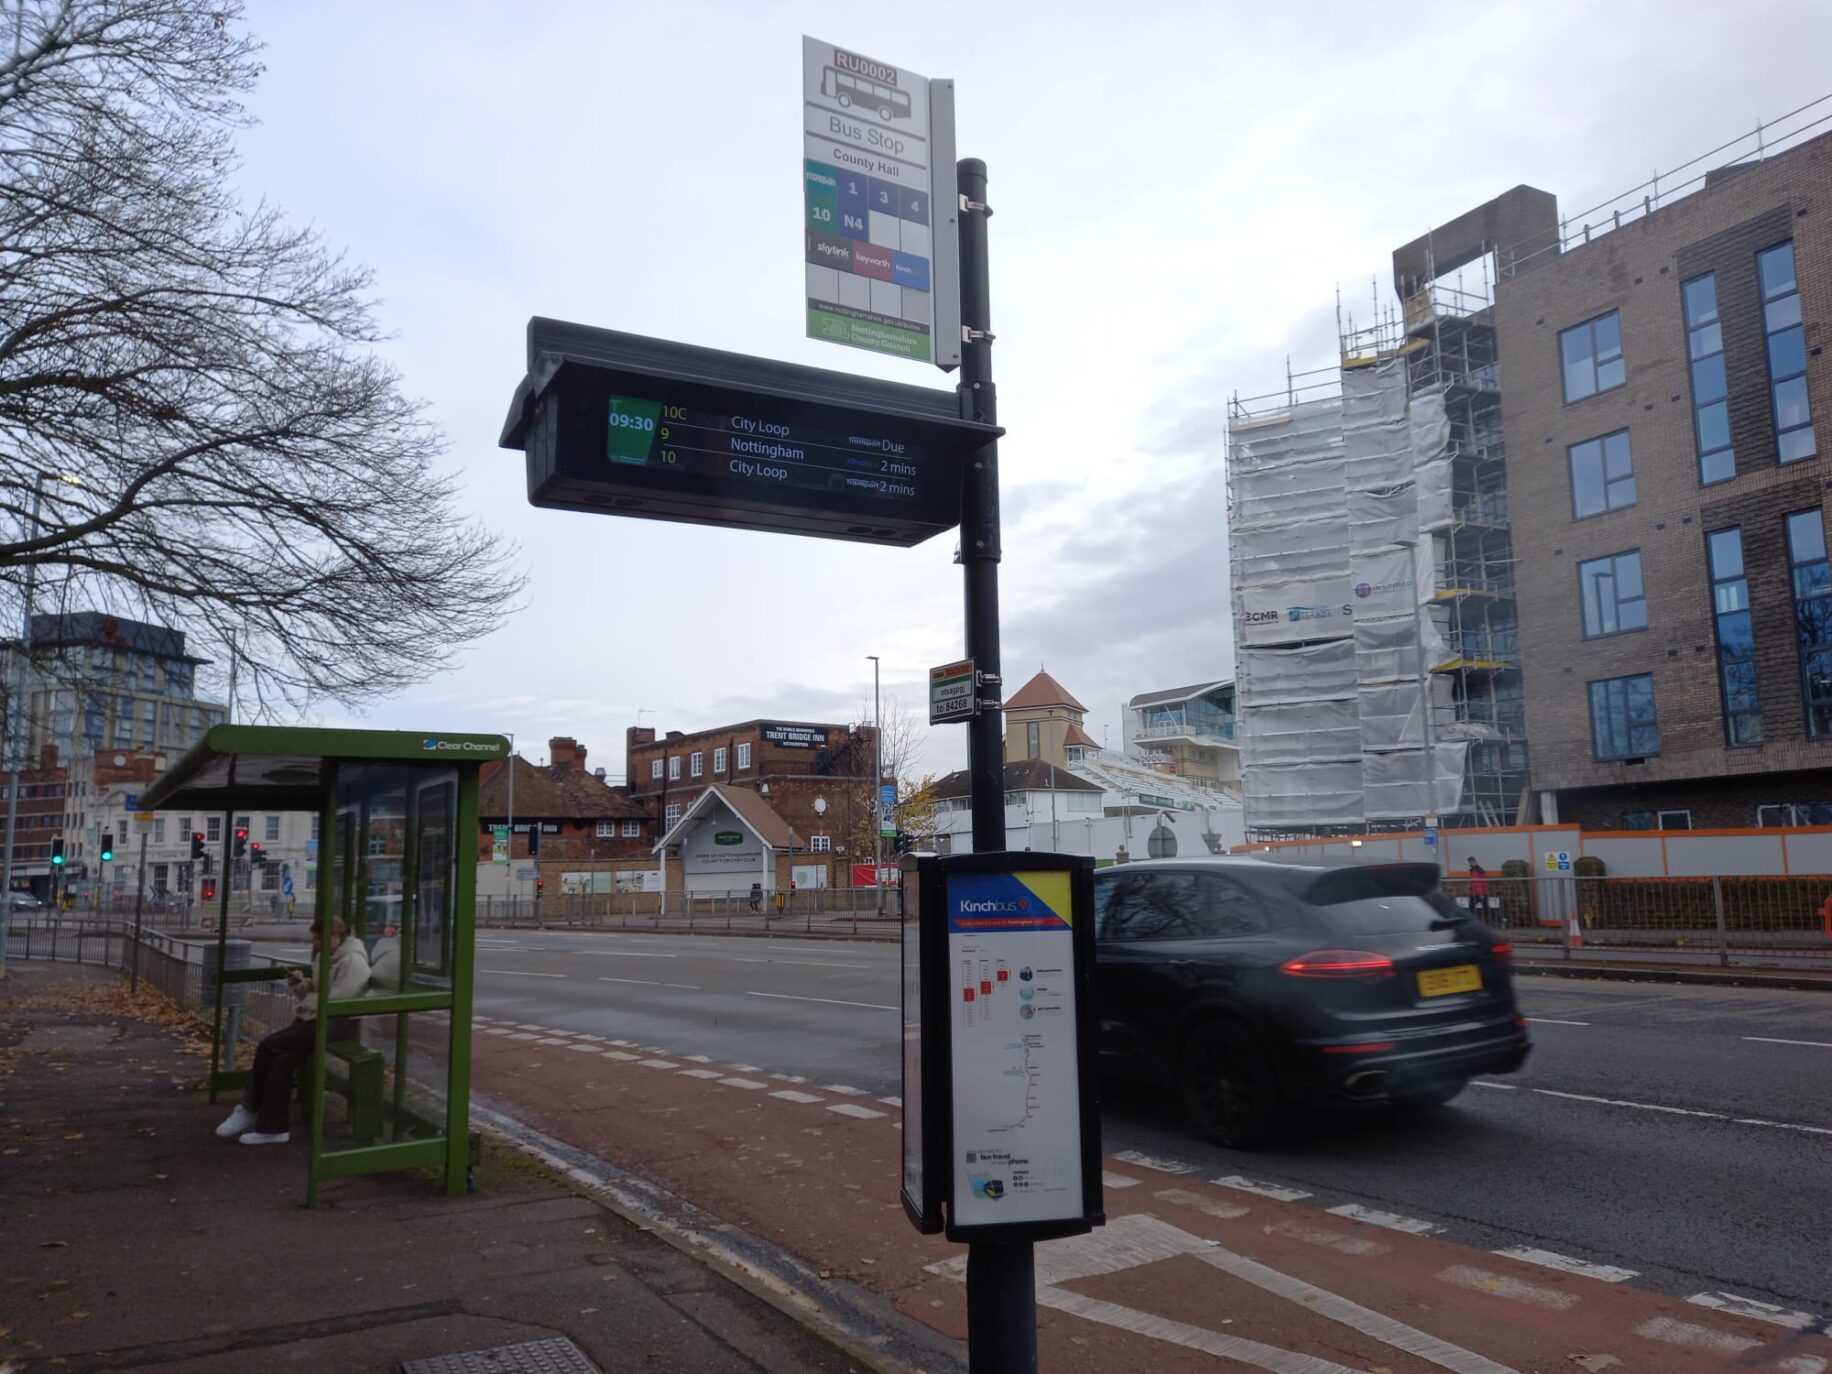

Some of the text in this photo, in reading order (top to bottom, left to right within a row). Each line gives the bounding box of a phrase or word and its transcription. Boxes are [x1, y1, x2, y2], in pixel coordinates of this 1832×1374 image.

[836, 52, 896, 84] RU0002
[830, 116, 904, 155] Bus Stop
[833, 148, 899, 177] County Hall
[849, 182, 858, 195] 1
[880, 191, 889, 204] 3
[812, 206, 831, 221] 10
[911, 201, 919, 213] 4
[844, 214, 864, 231] N4
[817, 242, 850, 258] skylink
[856, 252, 890, 268] keyworth
[851, 323, 917, 346] Nottinghamshire
[851, 333, 911, 353] County Council
[609, 412, 654, 431] 09:30
[663, 405, 687, 420] 10C
[731, 416, 756, 433] City
[759, 420, 790, 438] Loop
[882, 439, 905, 453] Due
[660, 427, 669, 440] 9
[731, 437, 804, 459] Nottingham
[880, 460, 888, 472] 2
[890, 463, 916, 476] mins
[661, 450, 676, 464] 10
[729, 459, 754, 477] City
[756, 463, 787, 481] Loop
[880, 480, 887, 492] 2
[889, 483, 915, 496] mins
[936, 699, 967, 714] to 84268
[765, 730, 825, 742] TRENT BRIDGE INN
[438, 740, 500, 752] Clear Channel
[960, 899, 1017, 913] Kinchbus
